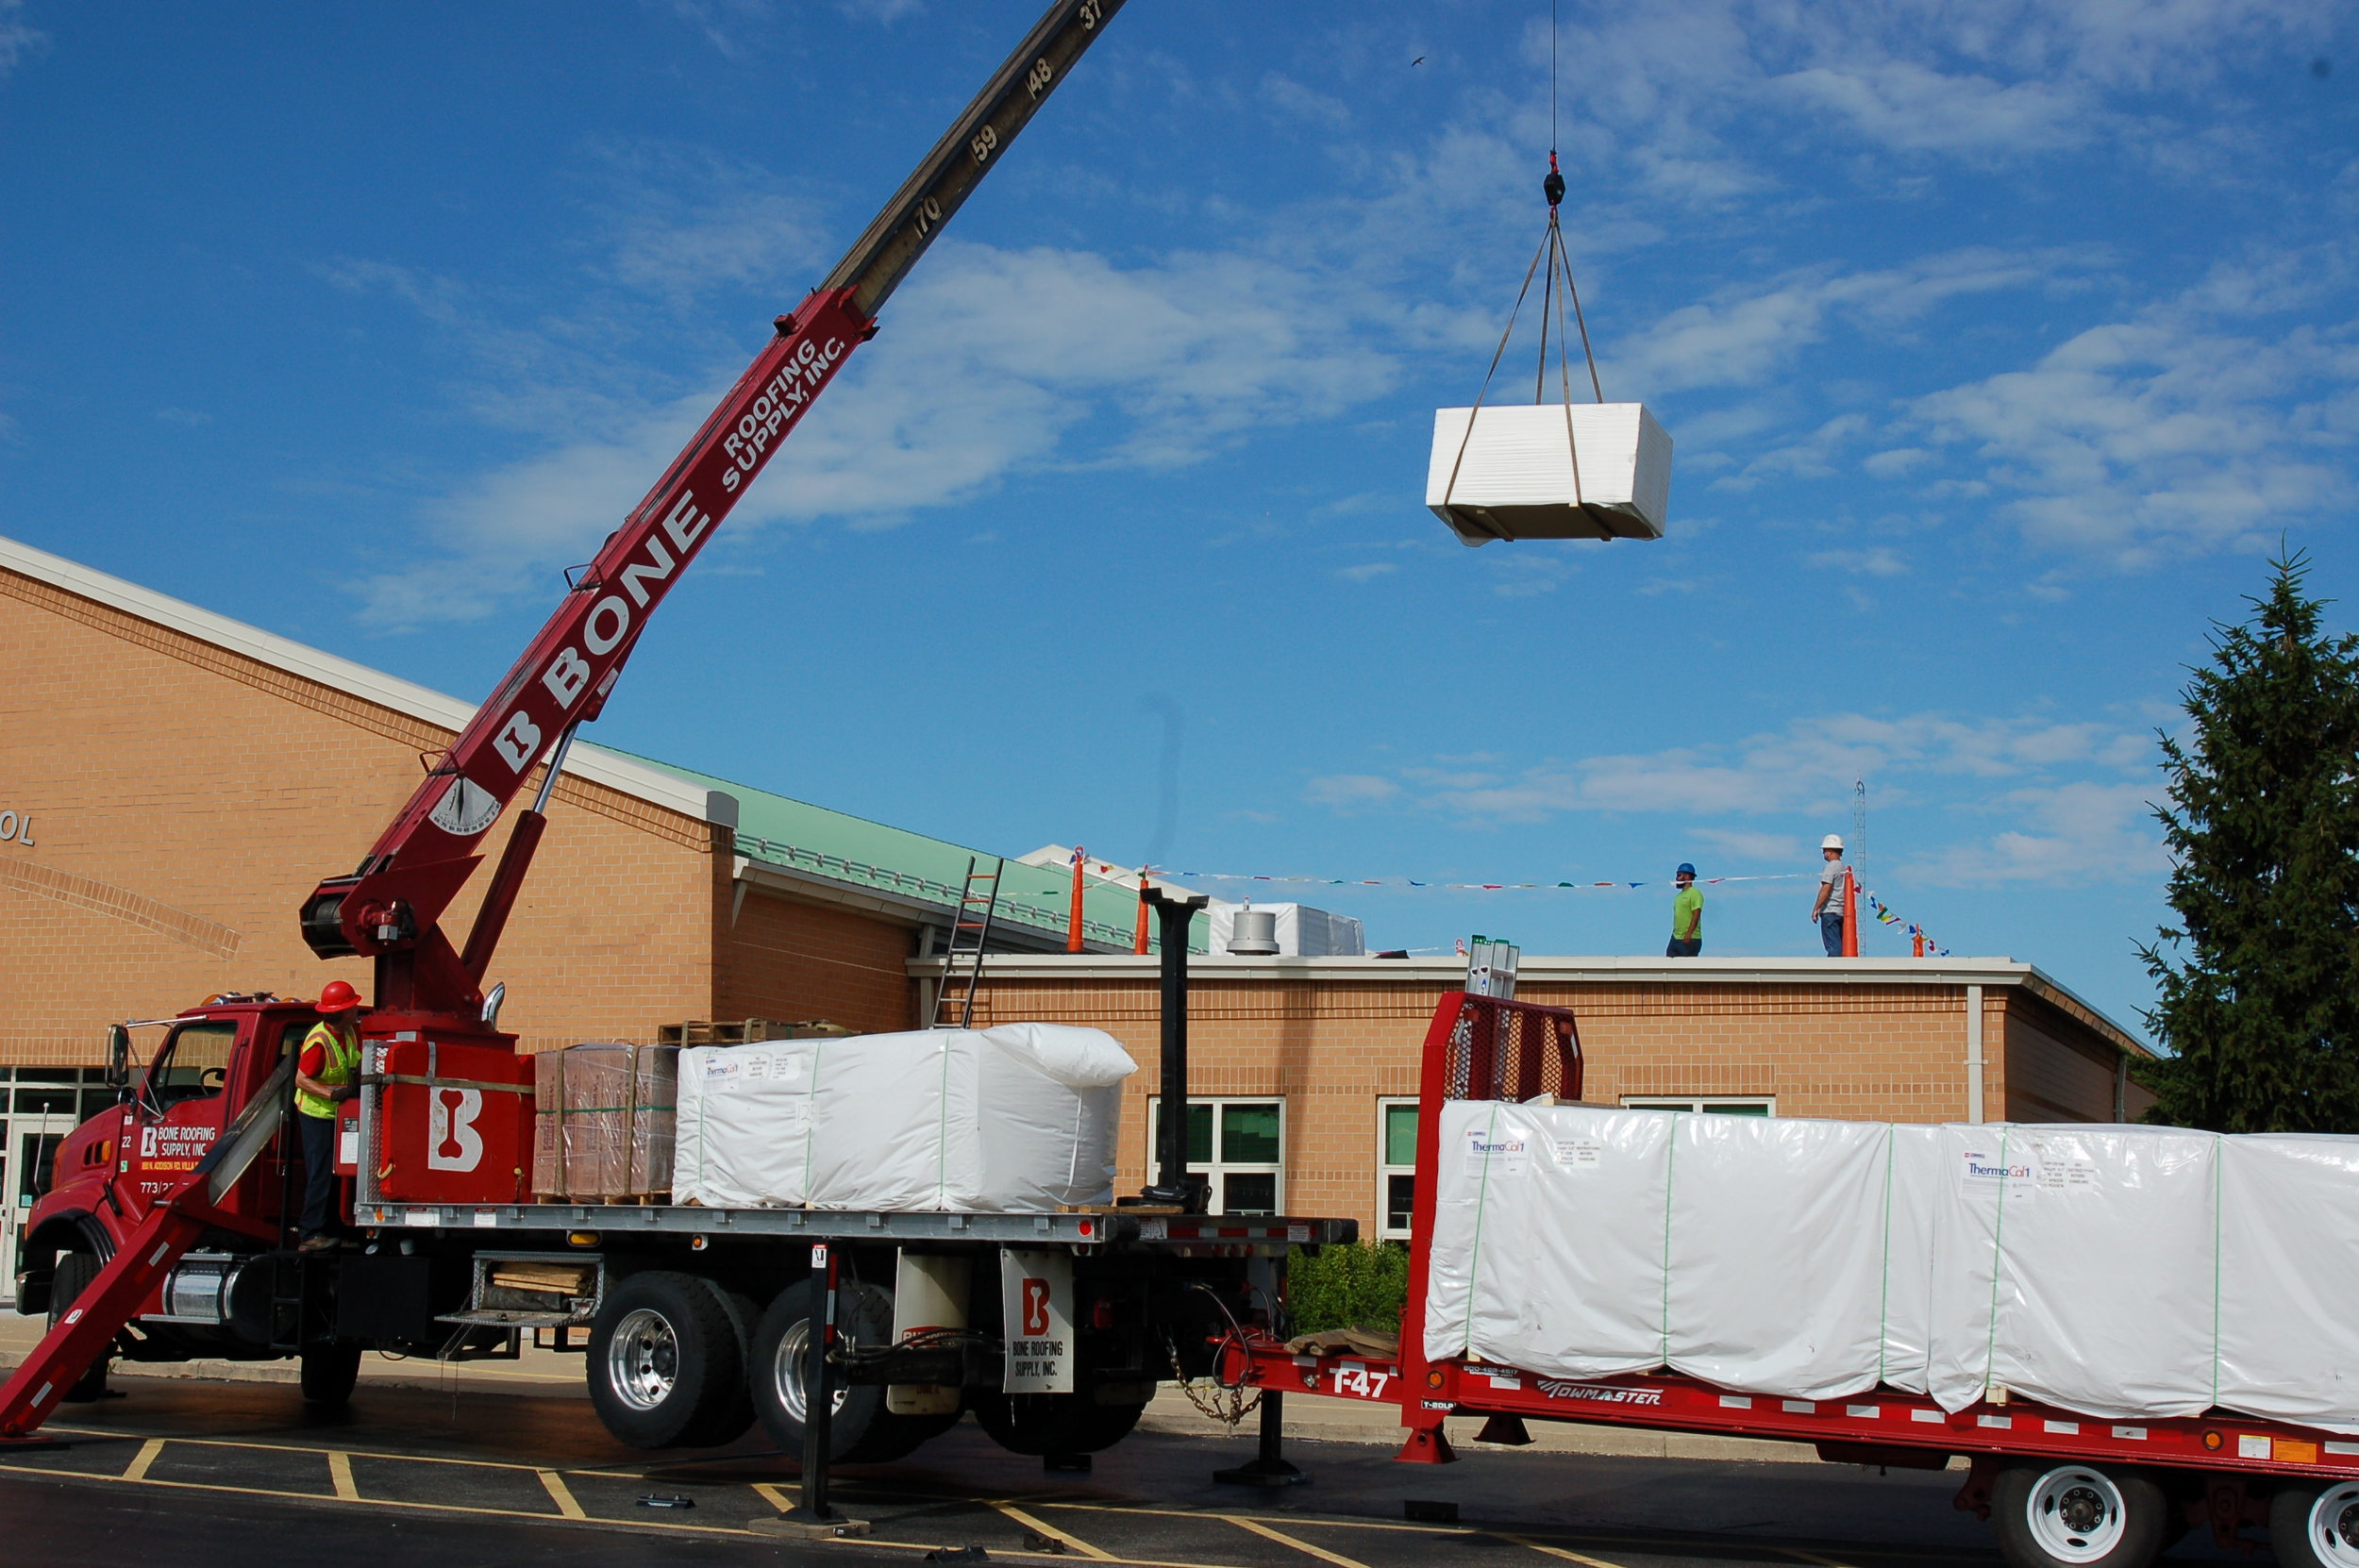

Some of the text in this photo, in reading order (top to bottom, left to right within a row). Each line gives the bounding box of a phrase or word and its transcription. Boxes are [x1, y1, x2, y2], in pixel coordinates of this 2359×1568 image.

[1079, 0, 1102, 29] 37
[1029, 58, 1052, 93] 48
[971, 125, 997, 161] 59
[915, 195, 941, 232] 70
[722, 337, 845, 492] SUPPLY, INC.
[723, 339, 816, 459] ROOFING
[541, 489, 711, 710] BONE
[121, 1136, 132, 1148] 22
[158, 1126, 179, 1142] BONE
[180, 1126, 216, 1142] ROOFING
[161, 1143, 191, 1158] SUPPLY,
[1012, 1341, 1063, 1357] BONE ROOFING
[1015, 1360, 1058, 1377] SUPPLY, INC.
